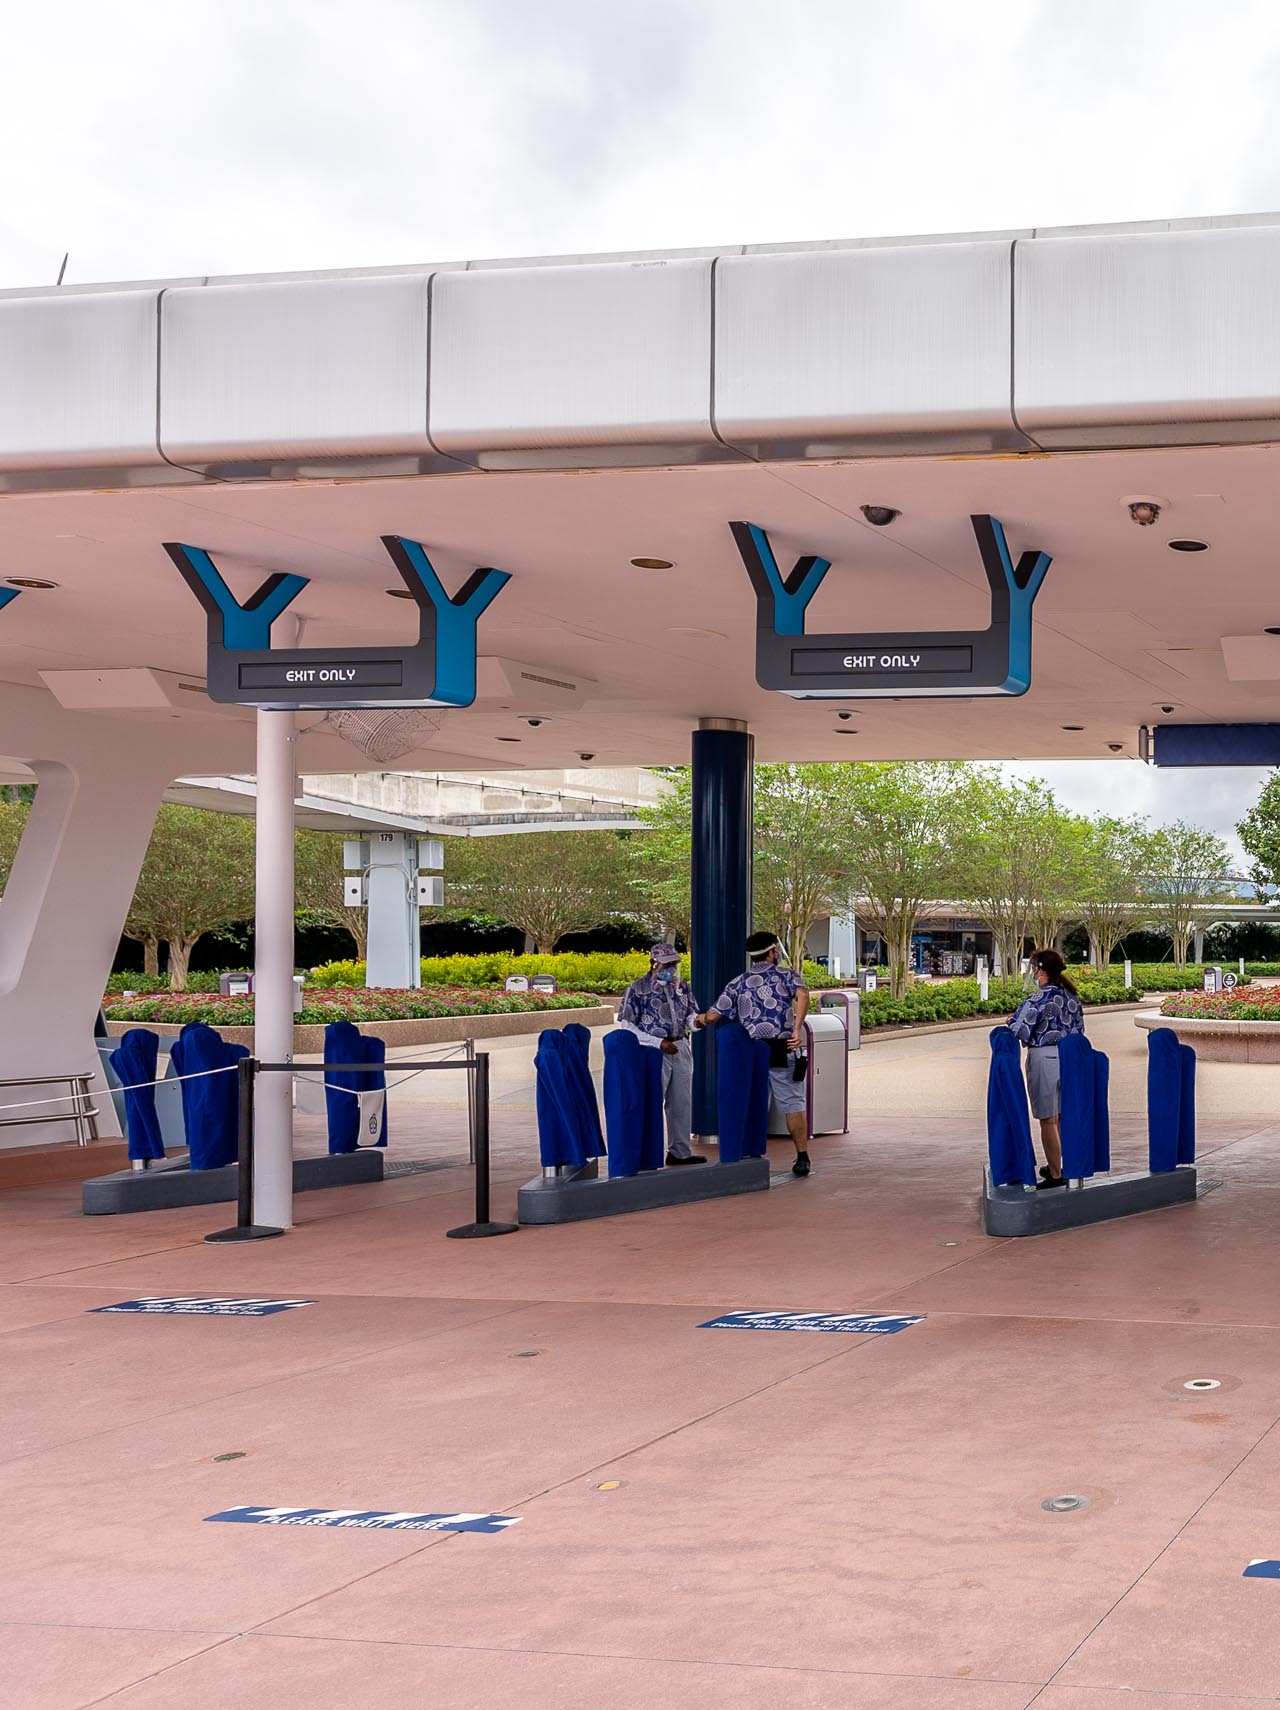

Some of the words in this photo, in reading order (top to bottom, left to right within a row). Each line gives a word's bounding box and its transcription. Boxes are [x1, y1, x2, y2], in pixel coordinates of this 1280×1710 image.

[843, 655, 876, 668] EXIT
[880, 655, 920, 668] ONLY
[285, 670, 316, 682] EXIT
[319, 669, 356, 681] ONLY
[380, 833, 393, 842] 179
[257, 1516, 338, 1526] PLEASE
[336, 1519, 395, 1528] WAIT
[391, 1521, 449, 1530] HERE
